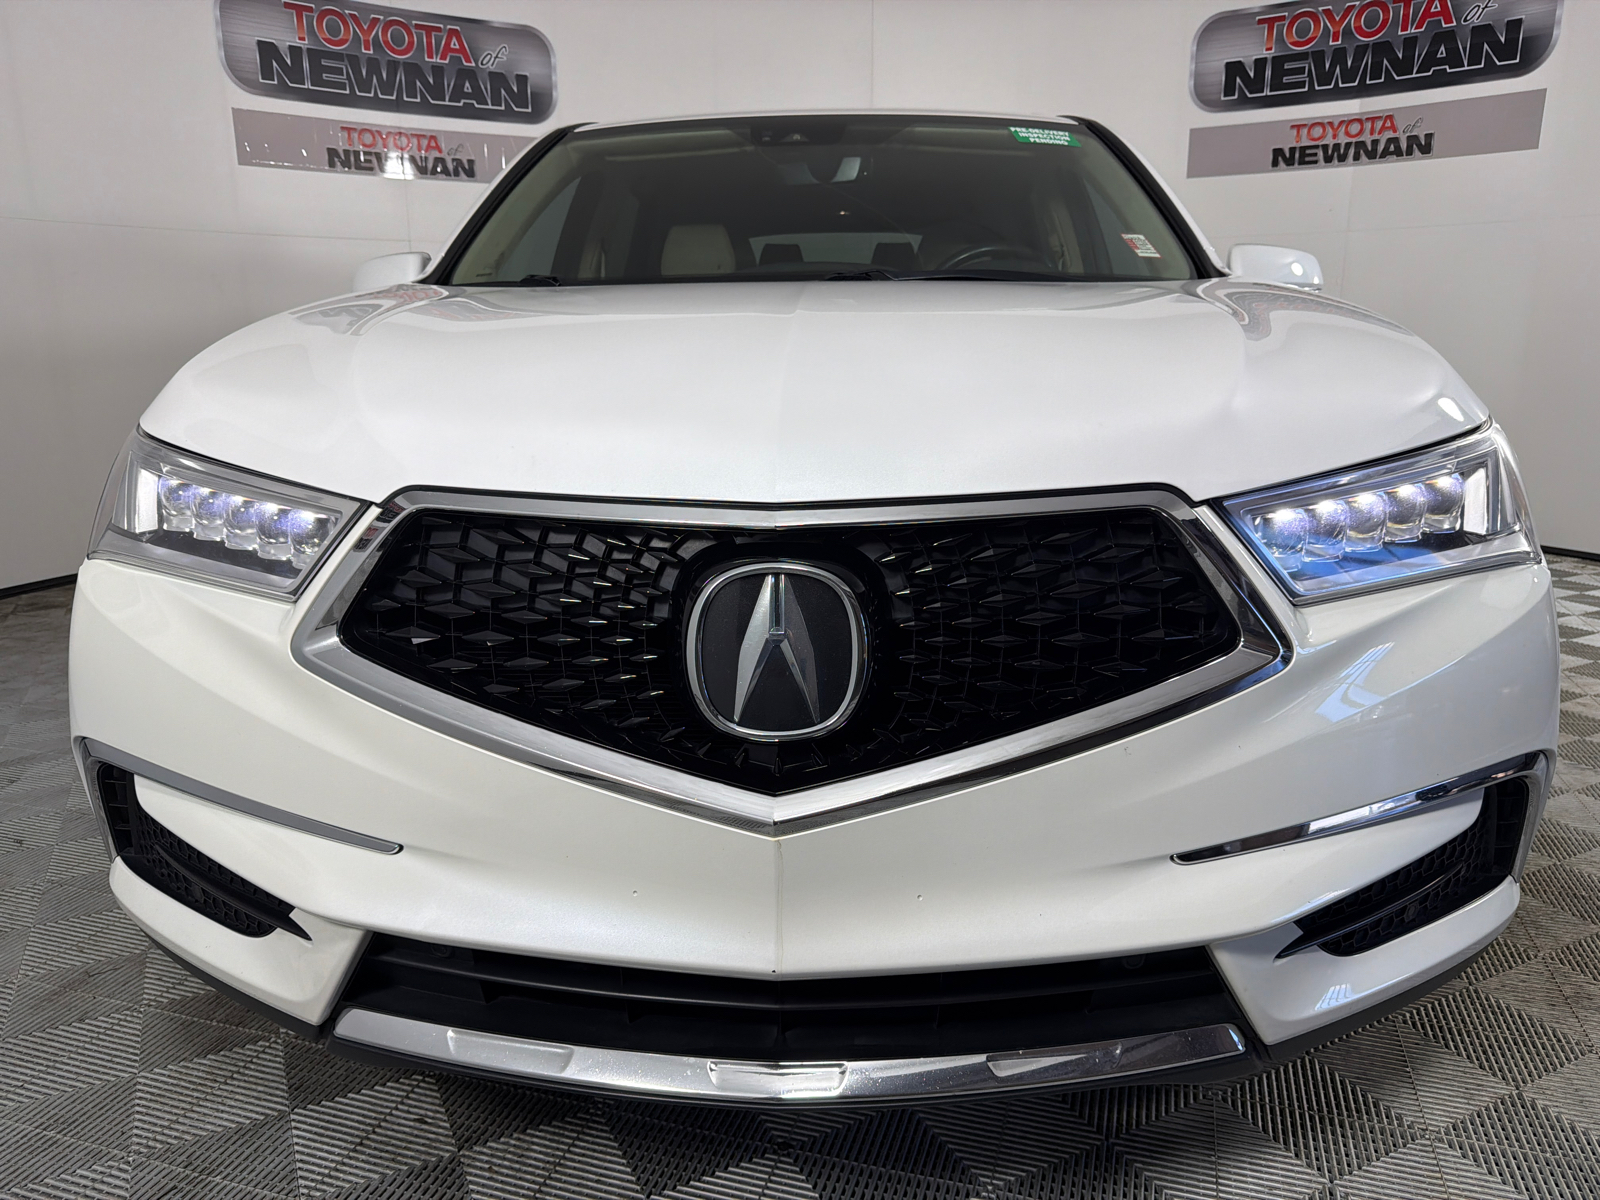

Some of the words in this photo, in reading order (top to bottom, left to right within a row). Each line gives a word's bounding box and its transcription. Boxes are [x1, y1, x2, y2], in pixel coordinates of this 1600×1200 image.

[283, 1, 475, 66] TOYOTA
[479, 46, 508, 68] of
[1256, 0, 1456, 53] TOYOTA
[256, 39, 532, 112] NEWNAN
[1221, 16, 1525, 100] NEWNAN
[340, 126, 443, 154] TOYOTA
[1018, 132, 1071, 141] INSPECTION
[1029, 137, 1068, 145] PENDING
[1290, 114, 1398, 143] TOYOTA
[1402, 117, 1424, 135] of
[1271, 133, 1435, 168] NEWNAN
